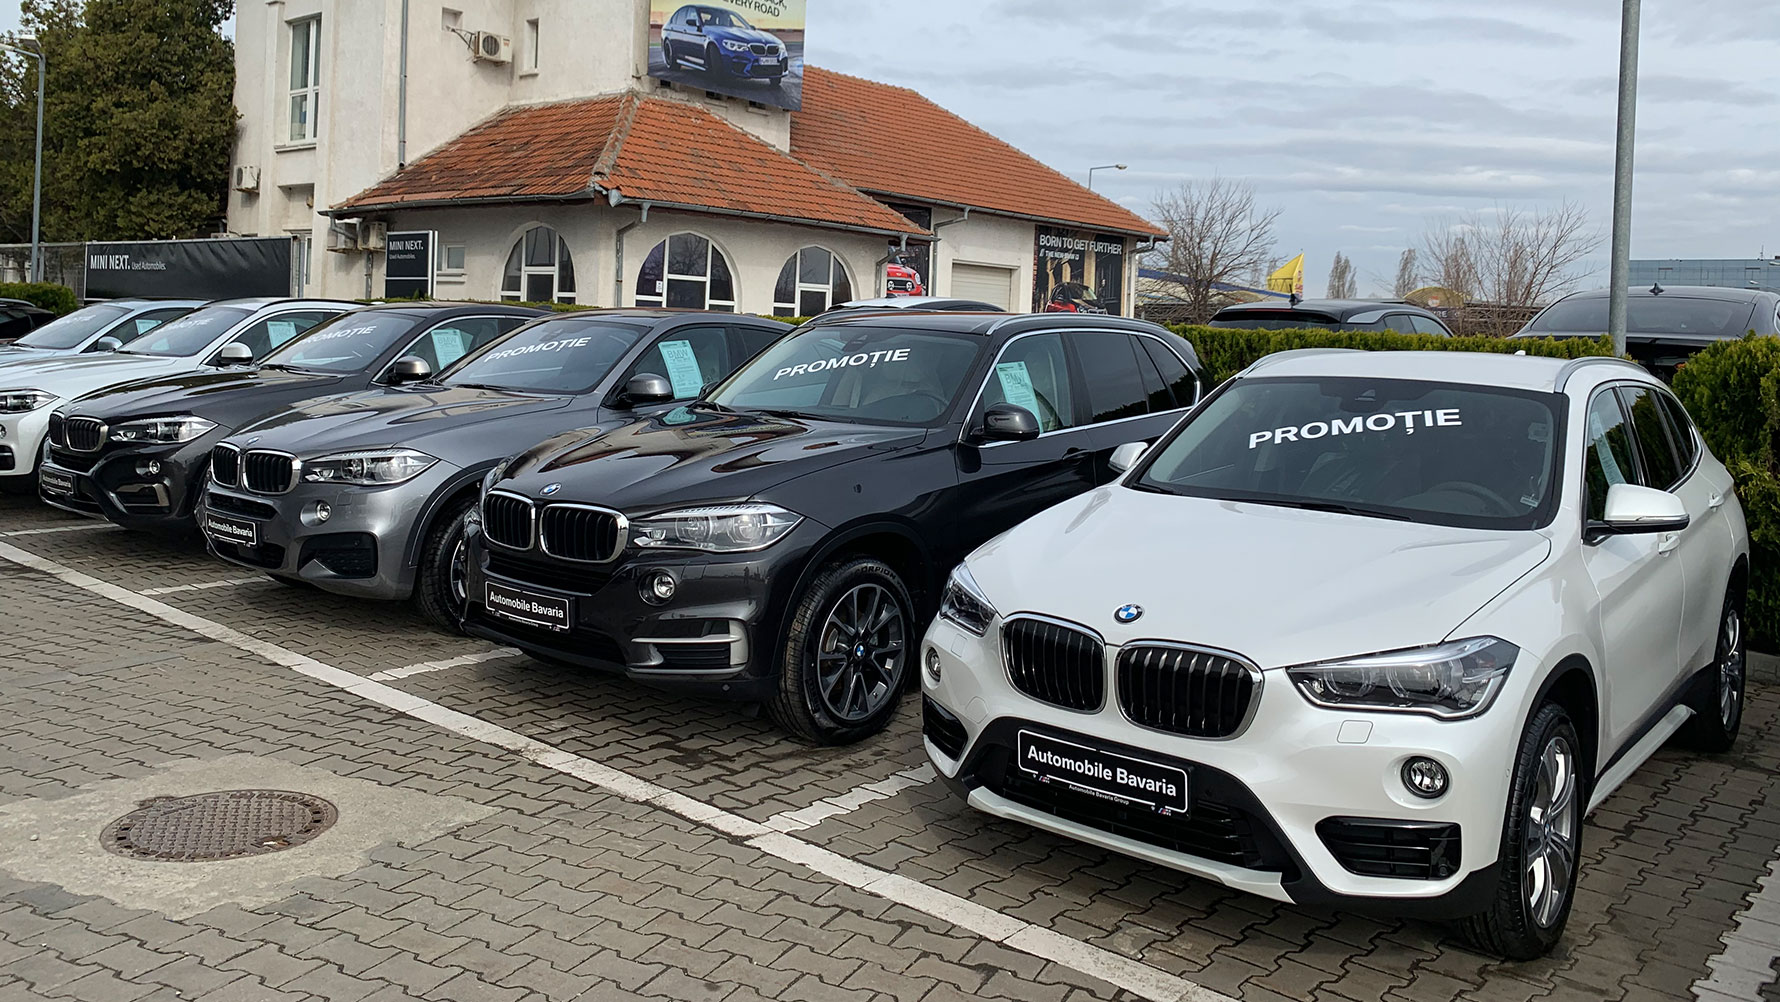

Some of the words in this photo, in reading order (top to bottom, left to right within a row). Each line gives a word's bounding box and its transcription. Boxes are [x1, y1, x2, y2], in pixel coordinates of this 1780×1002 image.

[723, 0, 754, 9] ERY
[754, 2, 780, 17] ROAD
[390, 241, 404, 250] MINI
[1040, 234, 1061, 247] BORN
[1062, 237, 1073, 249] TO
[1074, 239, 1089, 251] GET
[1089, 240, 1122, 255] FURTHER
[90, 254, 108, 270] MINI
[109, 254, 131, 270] NEXT.
[773, 348, 911, 381] PROMOȚIE
[1248, 408, 1463, 449] PROMOȚIE
[208, 518, 232, 534] Automobile
[232, 525, 253, 538] Bavaria
[489, 591, 531, 612] Automobile
[531, 602, 564, 618] Bavaria
[1027, 745, 1113, 781] Automobile
[1116, 767, 1177, 797] Bavaria
[1113, 796, 1130, 805] Group
